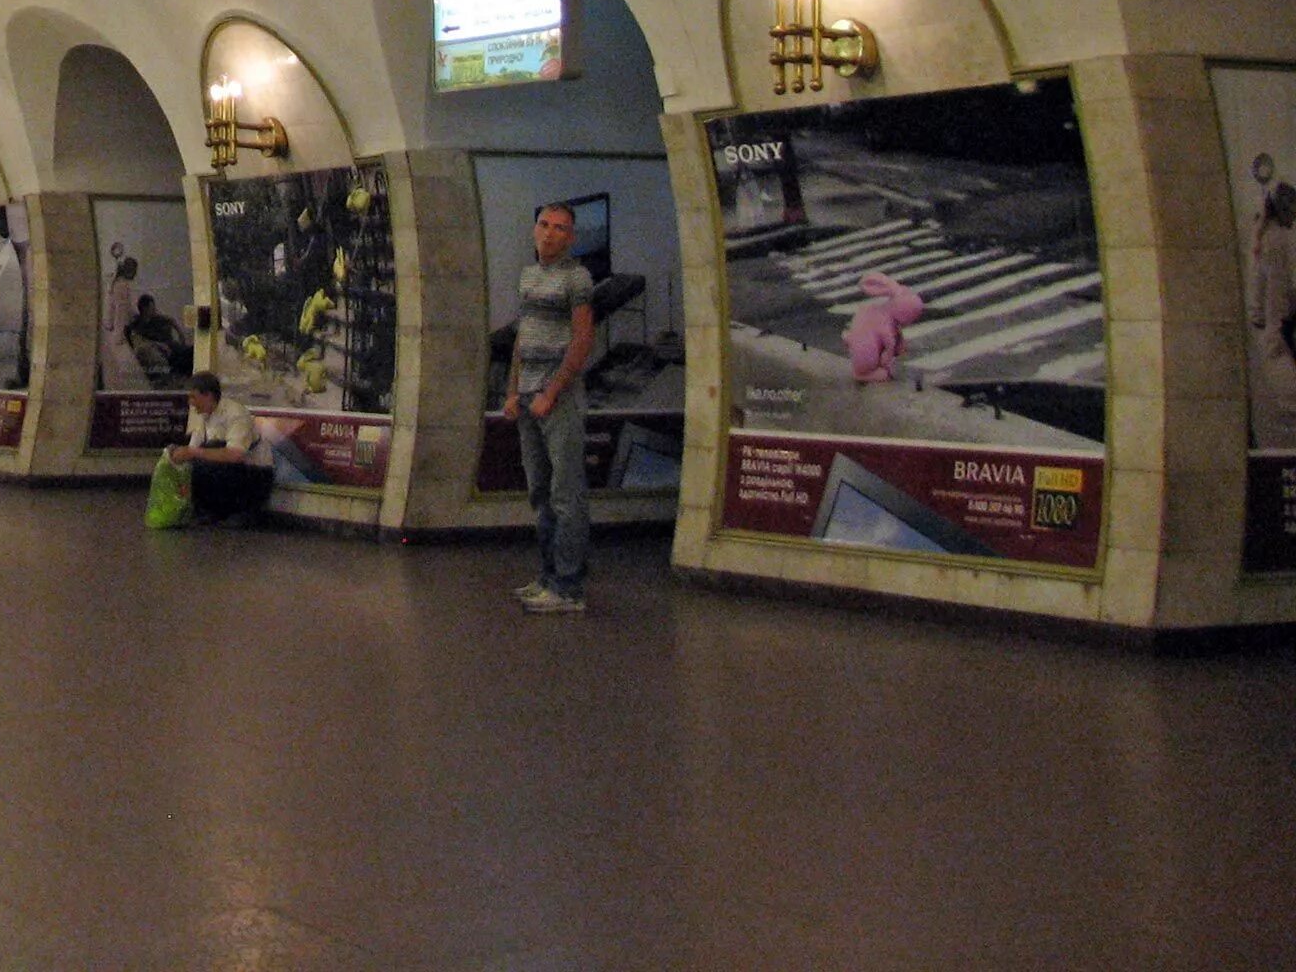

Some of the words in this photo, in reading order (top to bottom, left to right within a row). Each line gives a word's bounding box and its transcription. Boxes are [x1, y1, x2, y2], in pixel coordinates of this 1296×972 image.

[724, 141, 783, 164] SONY
[214, 200, 245, 216] SONY
[954, 460, 1025, 485] BRAVIA
[1036, 494, 1078, 526] 1080
